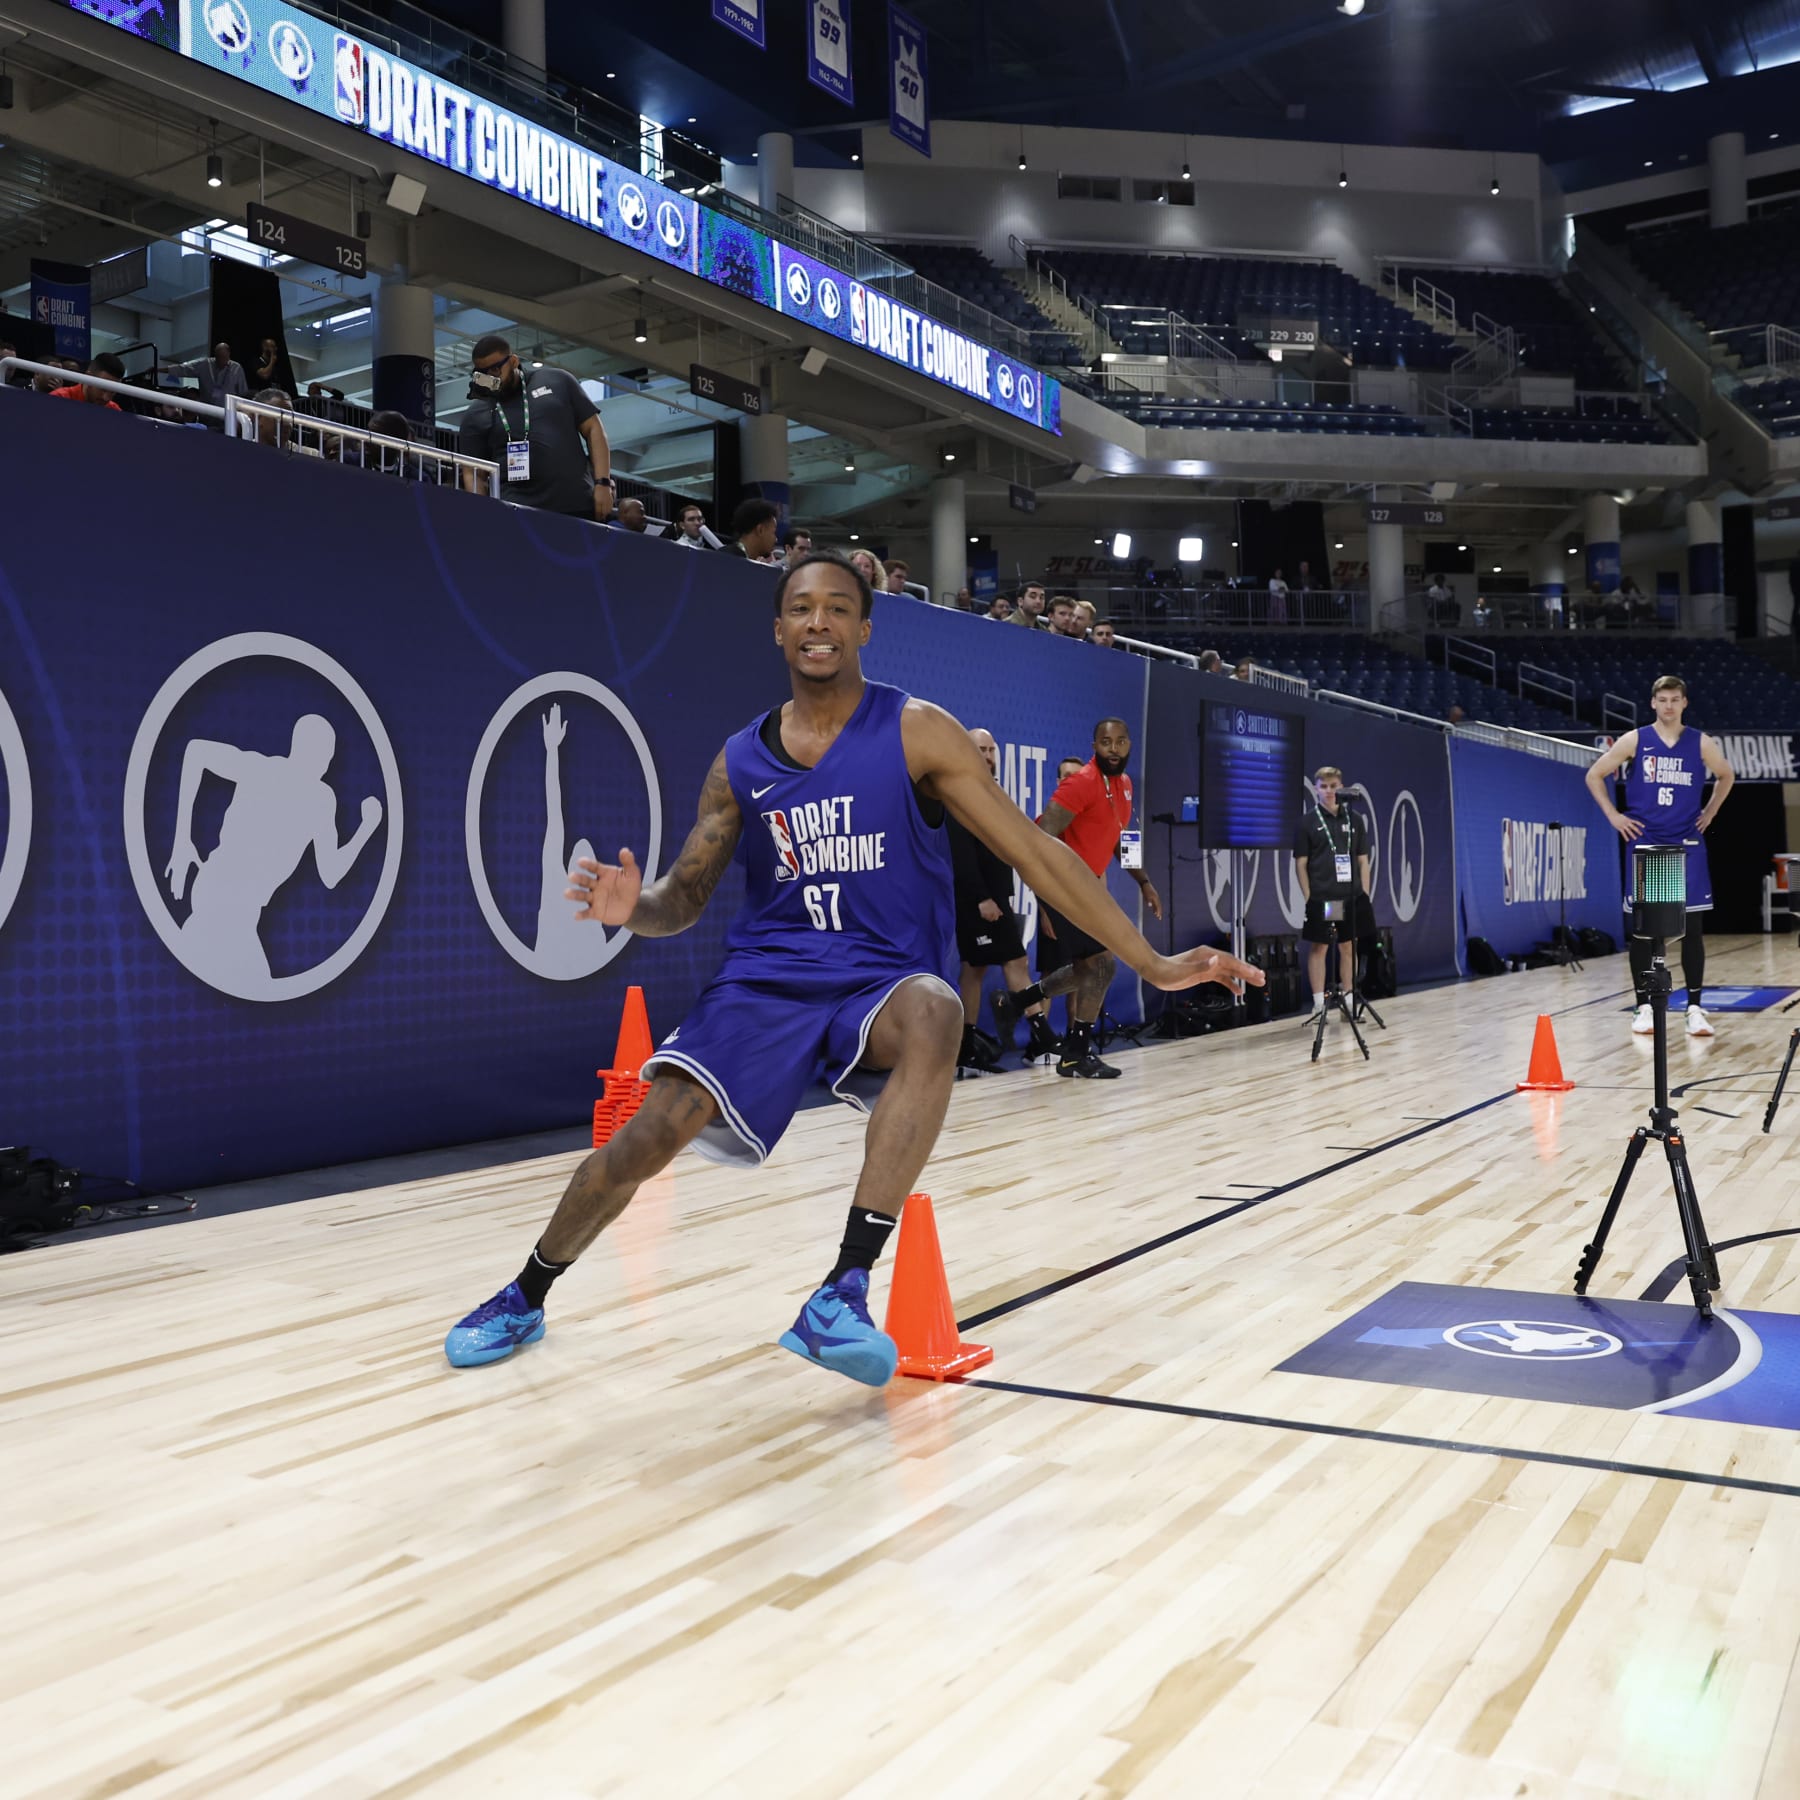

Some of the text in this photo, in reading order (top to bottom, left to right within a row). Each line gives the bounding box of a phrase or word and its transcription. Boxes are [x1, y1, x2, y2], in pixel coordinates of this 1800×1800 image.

[819, 18, 841, 46] 99
[899, 76, 919, 100] 40
[368, 50, 604, 228] DRAFT COMBINE
[256, 218, 286, 244] 124
[335, 246, 363, 270] 125
[50, 298, 76, 314] DRAFT
[50, 312, 86, 329] COMBINE
[866, 290, 991, 400] DRAFT COMBINE
[1269, 330, 1289, 341] 229
[1294, 331, 1315, 342] 230
[697, 375, 715, 394] 125
[742, 392, 760, 410] 126
[1370, 509, 1390, 521] 127
[1424, 511, 1444, 523] 128
[1656, 756, 1684, 773] DRAFT
[1705, 735, 1798, 780] MBINE
[993, 741, 1048, 820] AFT
[1656, 766, 1693, 787] COMBINE
[1657, 786, 1675, 806] 65
[790, 795, 855, 845] DRAFT
[1512, 820, 1546, 903] DRAFT
[802, 882, 843, 931] 67
